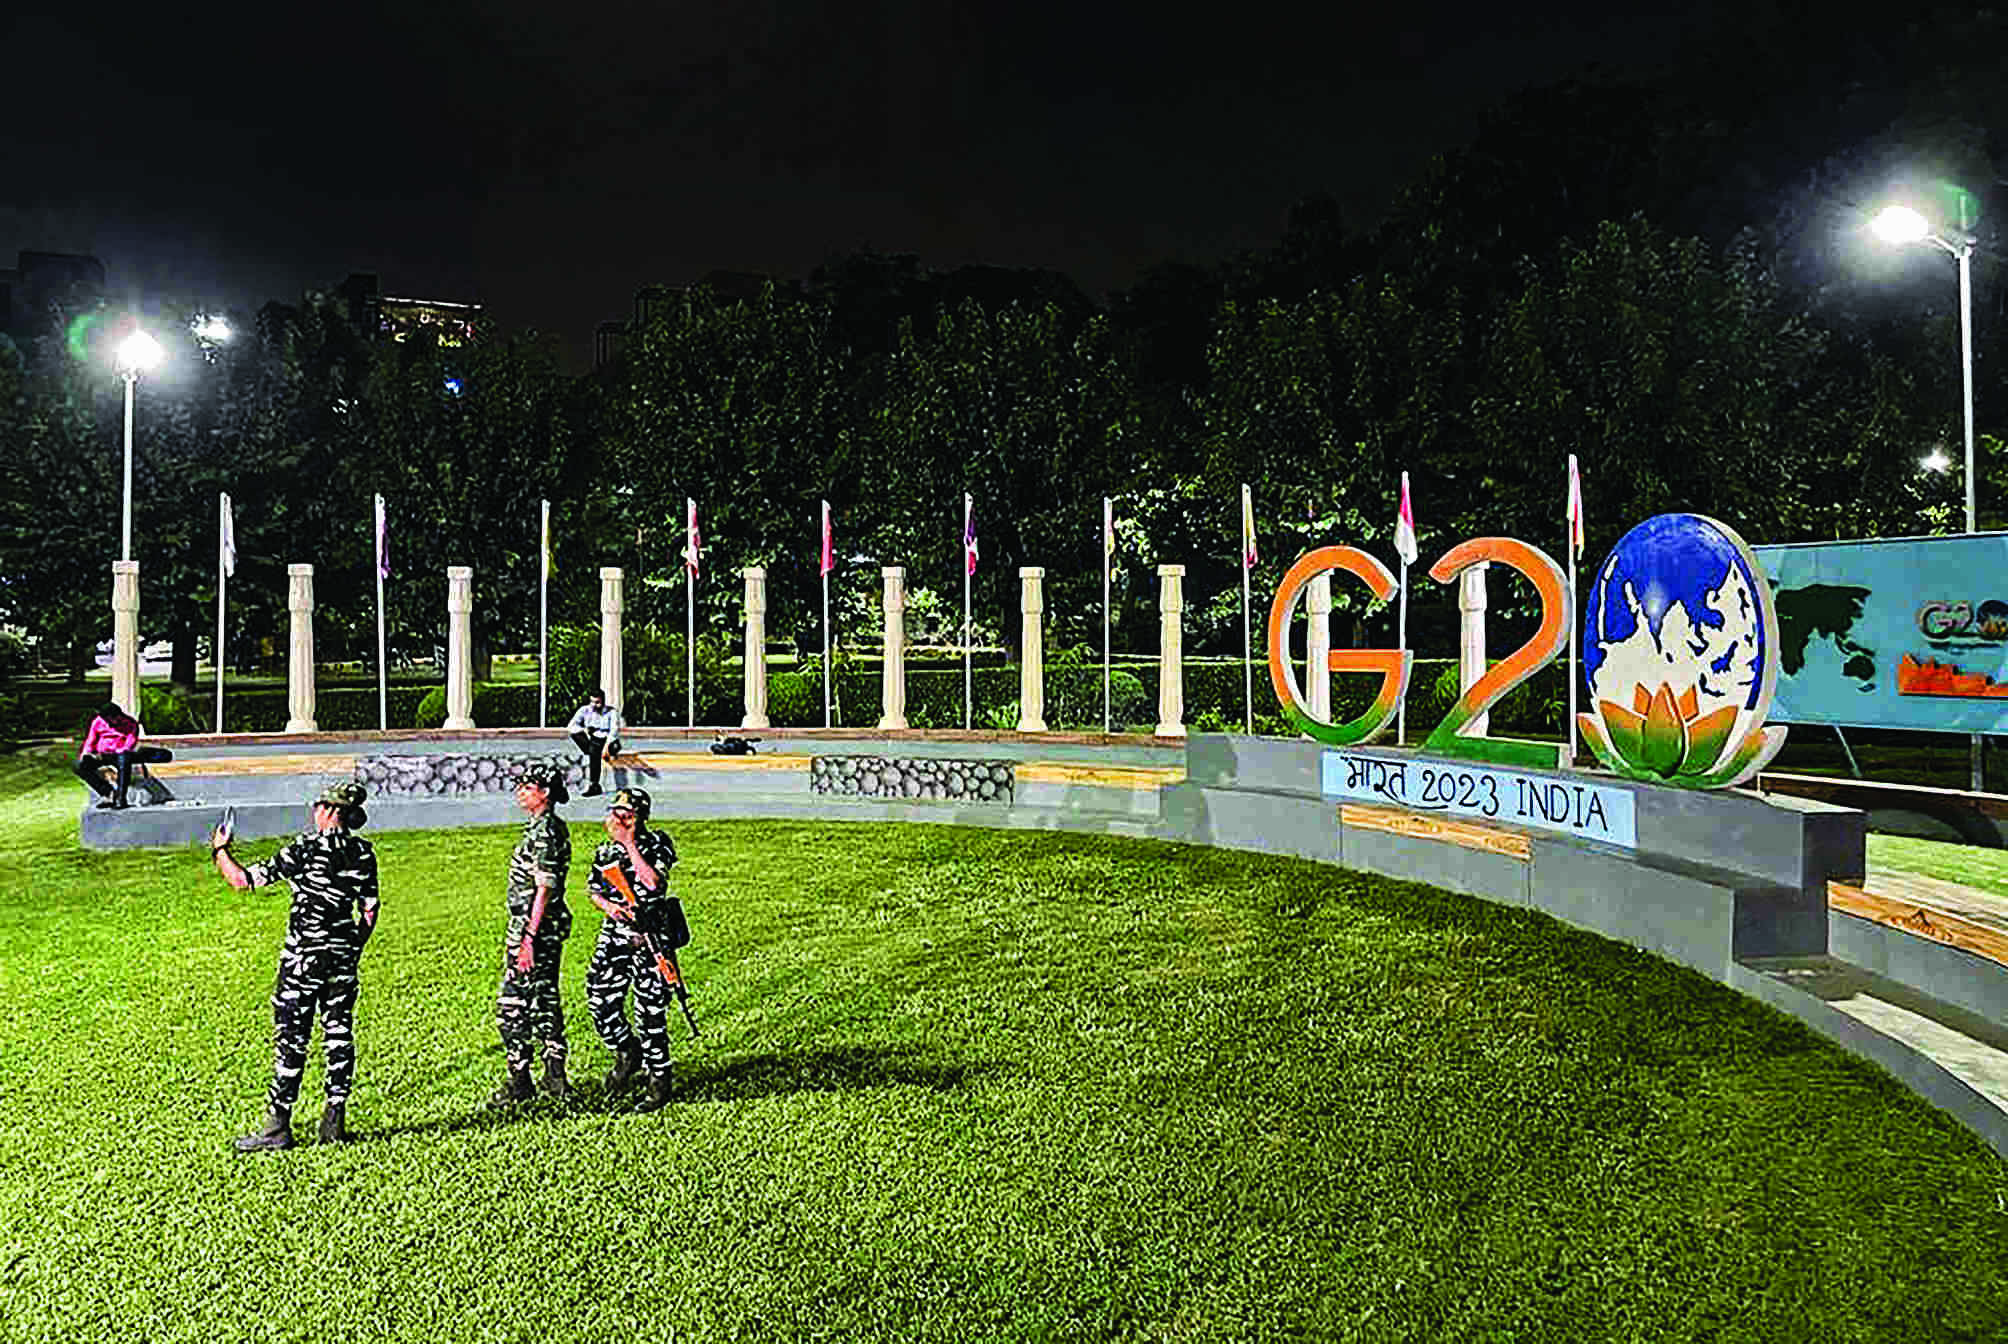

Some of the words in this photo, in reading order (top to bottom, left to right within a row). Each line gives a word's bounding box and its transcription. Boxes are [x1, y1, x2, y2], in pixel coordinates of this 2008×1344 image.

[1340, 756, 1448, 809] भारत
[1422, 769, 1500, 816] 2023
[1516, 777, 1608, 831] INDIA
